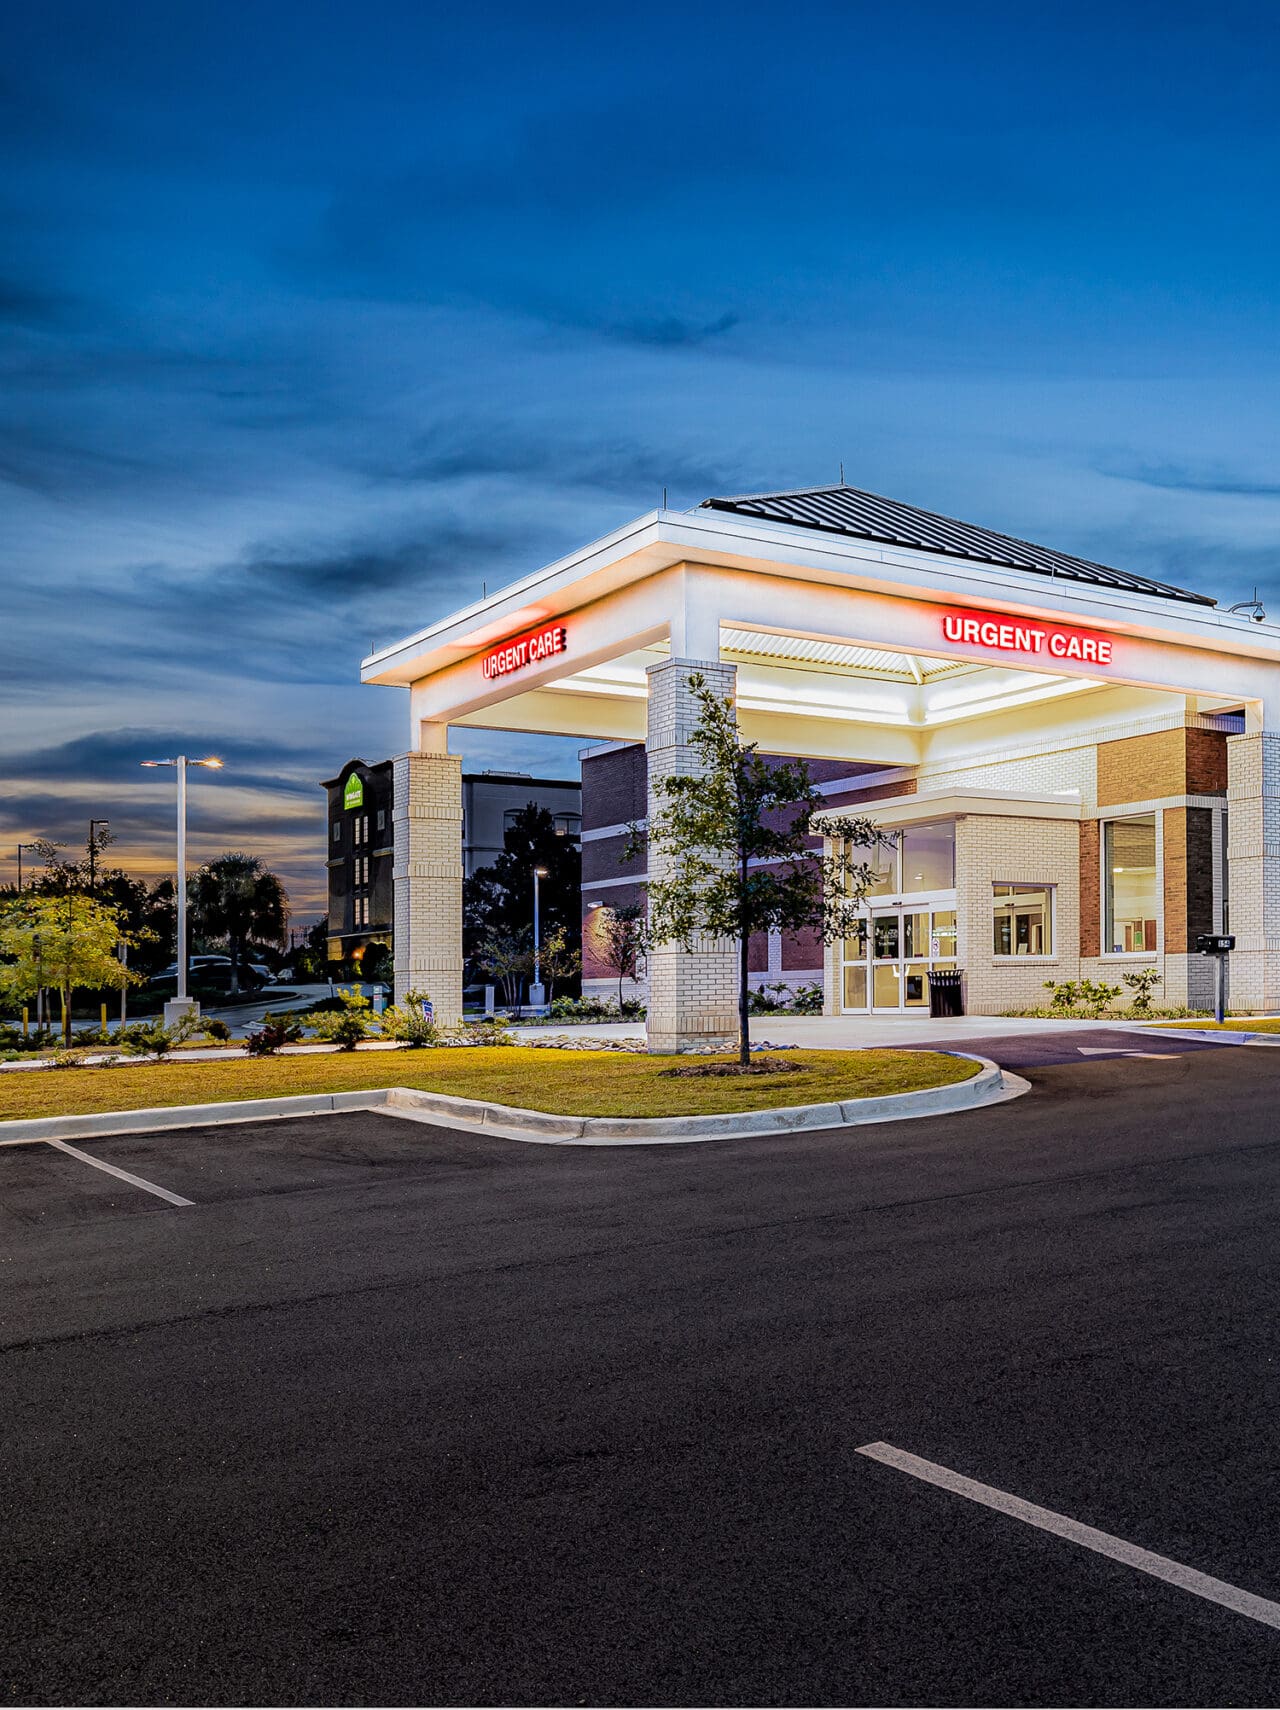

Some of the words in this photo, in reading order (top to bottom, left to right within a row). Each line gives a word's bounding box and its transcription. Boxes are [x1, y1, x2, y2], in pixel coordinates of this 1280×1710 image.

[483, 642, 527, 679] URGENT
[529, 627, 562, 660] CARE
[945, 616, 1046, 652] URGENT
[1050, 633, 1112, 663] CARE
